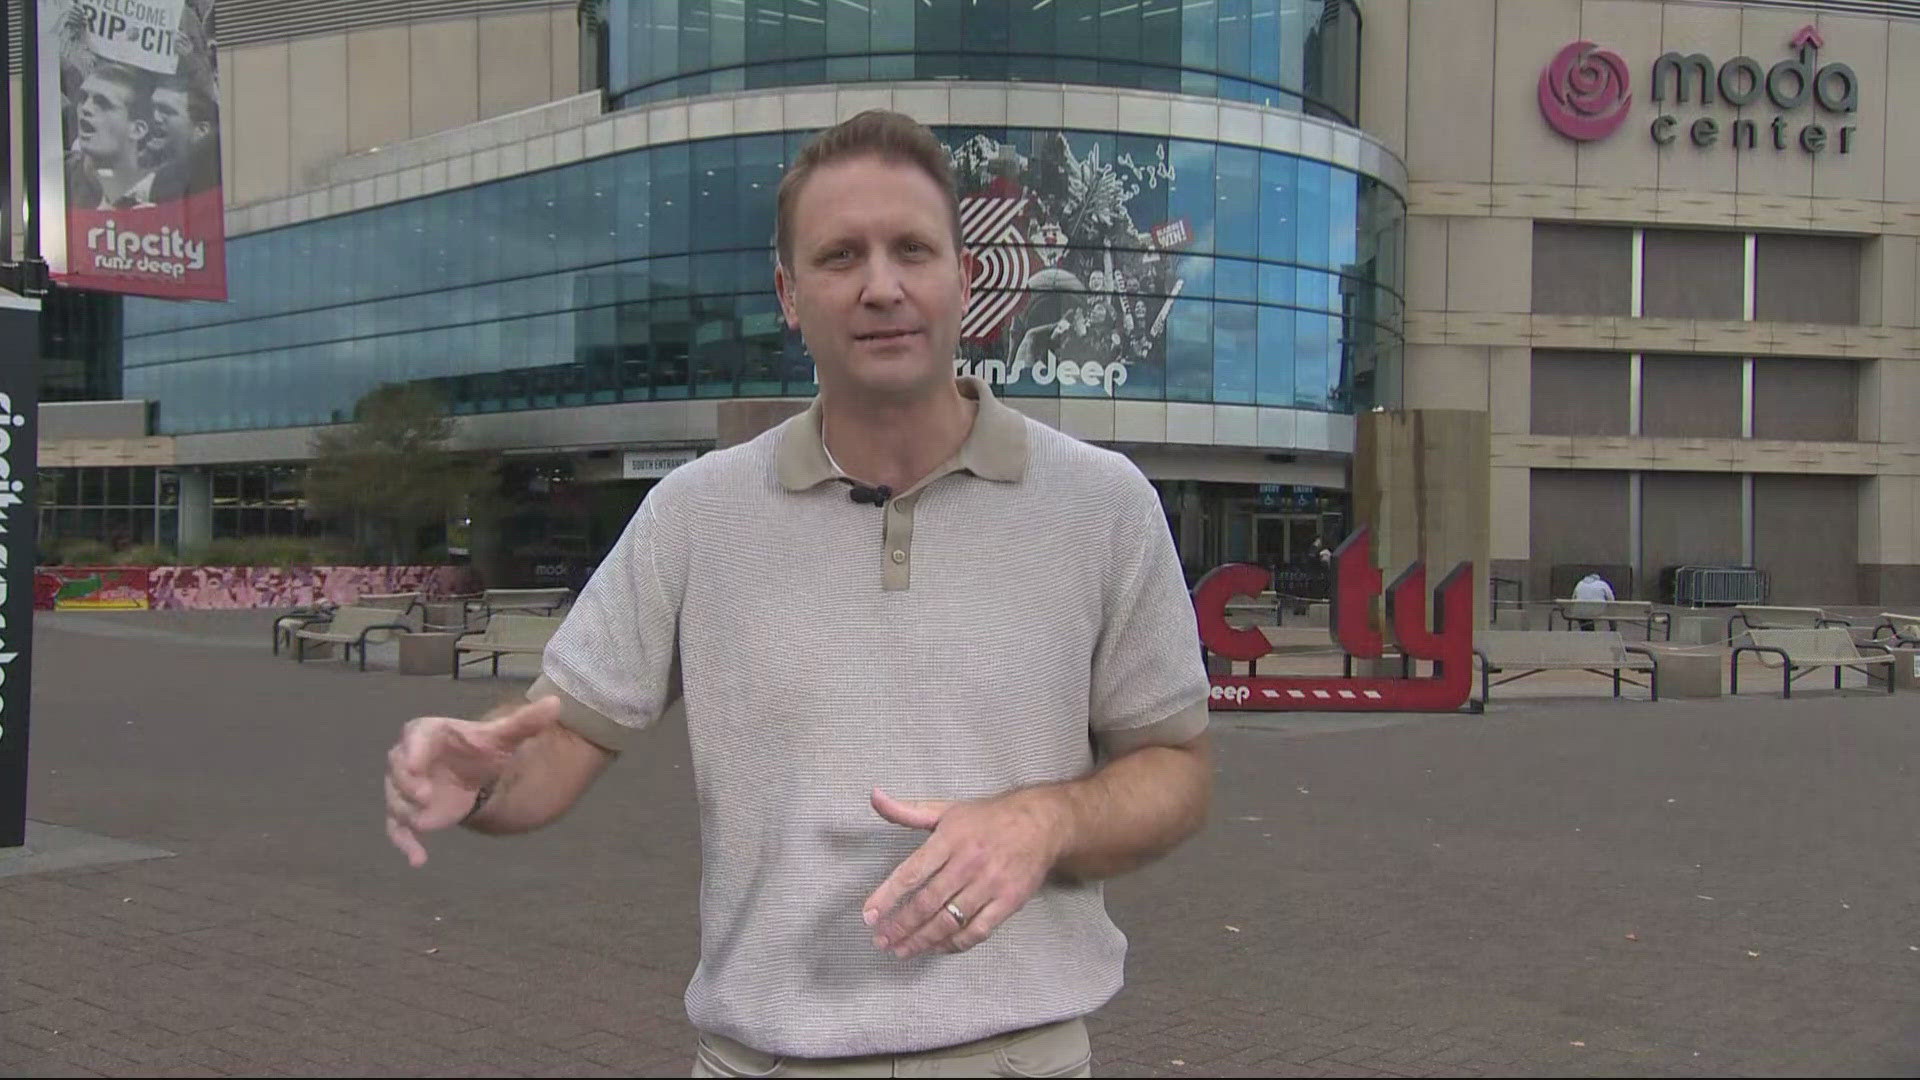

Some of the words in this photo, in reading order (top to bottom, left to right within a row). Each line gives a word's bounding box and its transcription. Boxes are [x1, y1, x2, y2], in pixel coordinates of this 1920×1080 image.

[82, 4, 126, 40] RIP
[140, 26, 174, 56] CIT
[95, 0, 167, 27] ELCOME
[1651, 25, 1858, 113] moda
[1651, 115, 1856, 154] center
[87, 219, 205, 270] ripcity
[95, 255, 133, 270] runs
[137, 255, 185, 279] deep
[1031, 349, 1128, 398] deep
[632, 460, 653, 470] SOUTH
[1210, 685, 1250, 706] eep
